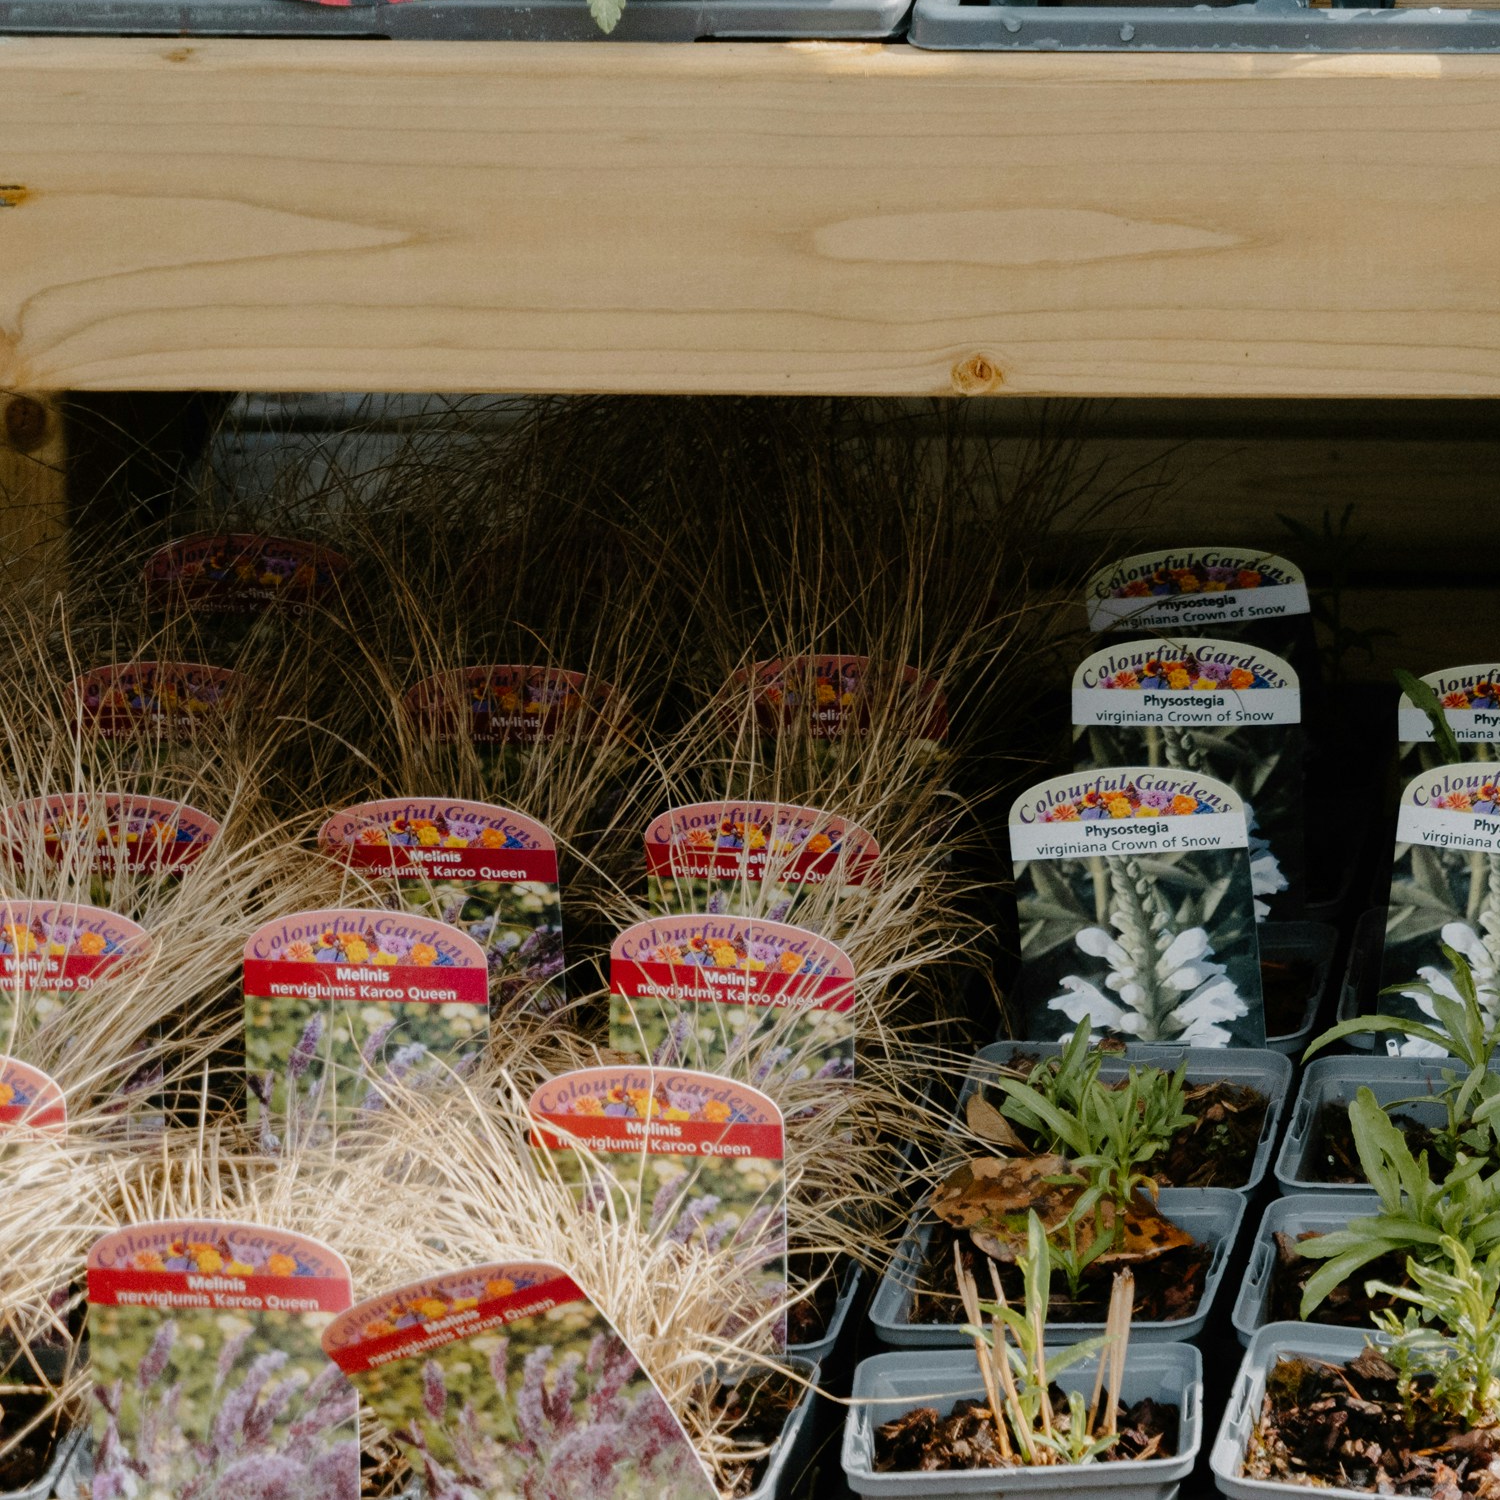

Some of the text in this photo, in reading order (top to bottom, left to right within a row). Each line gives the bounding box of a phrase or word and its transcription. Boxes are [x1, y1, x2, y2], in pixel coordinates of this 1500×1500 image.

[1019, 774, 1232, 824] Colourful Gardens
[1085, 823, 1169, 838] Physostegia
[1036, 836, 1221, 857] virginiana Crown of Snow
[253, 916, 472, 968] Colourful Gardens
[336, 967, 390, 982] Melinis
[360, 985, 404, 999] Karoo
[407, 986, 457, 1001] Queen
